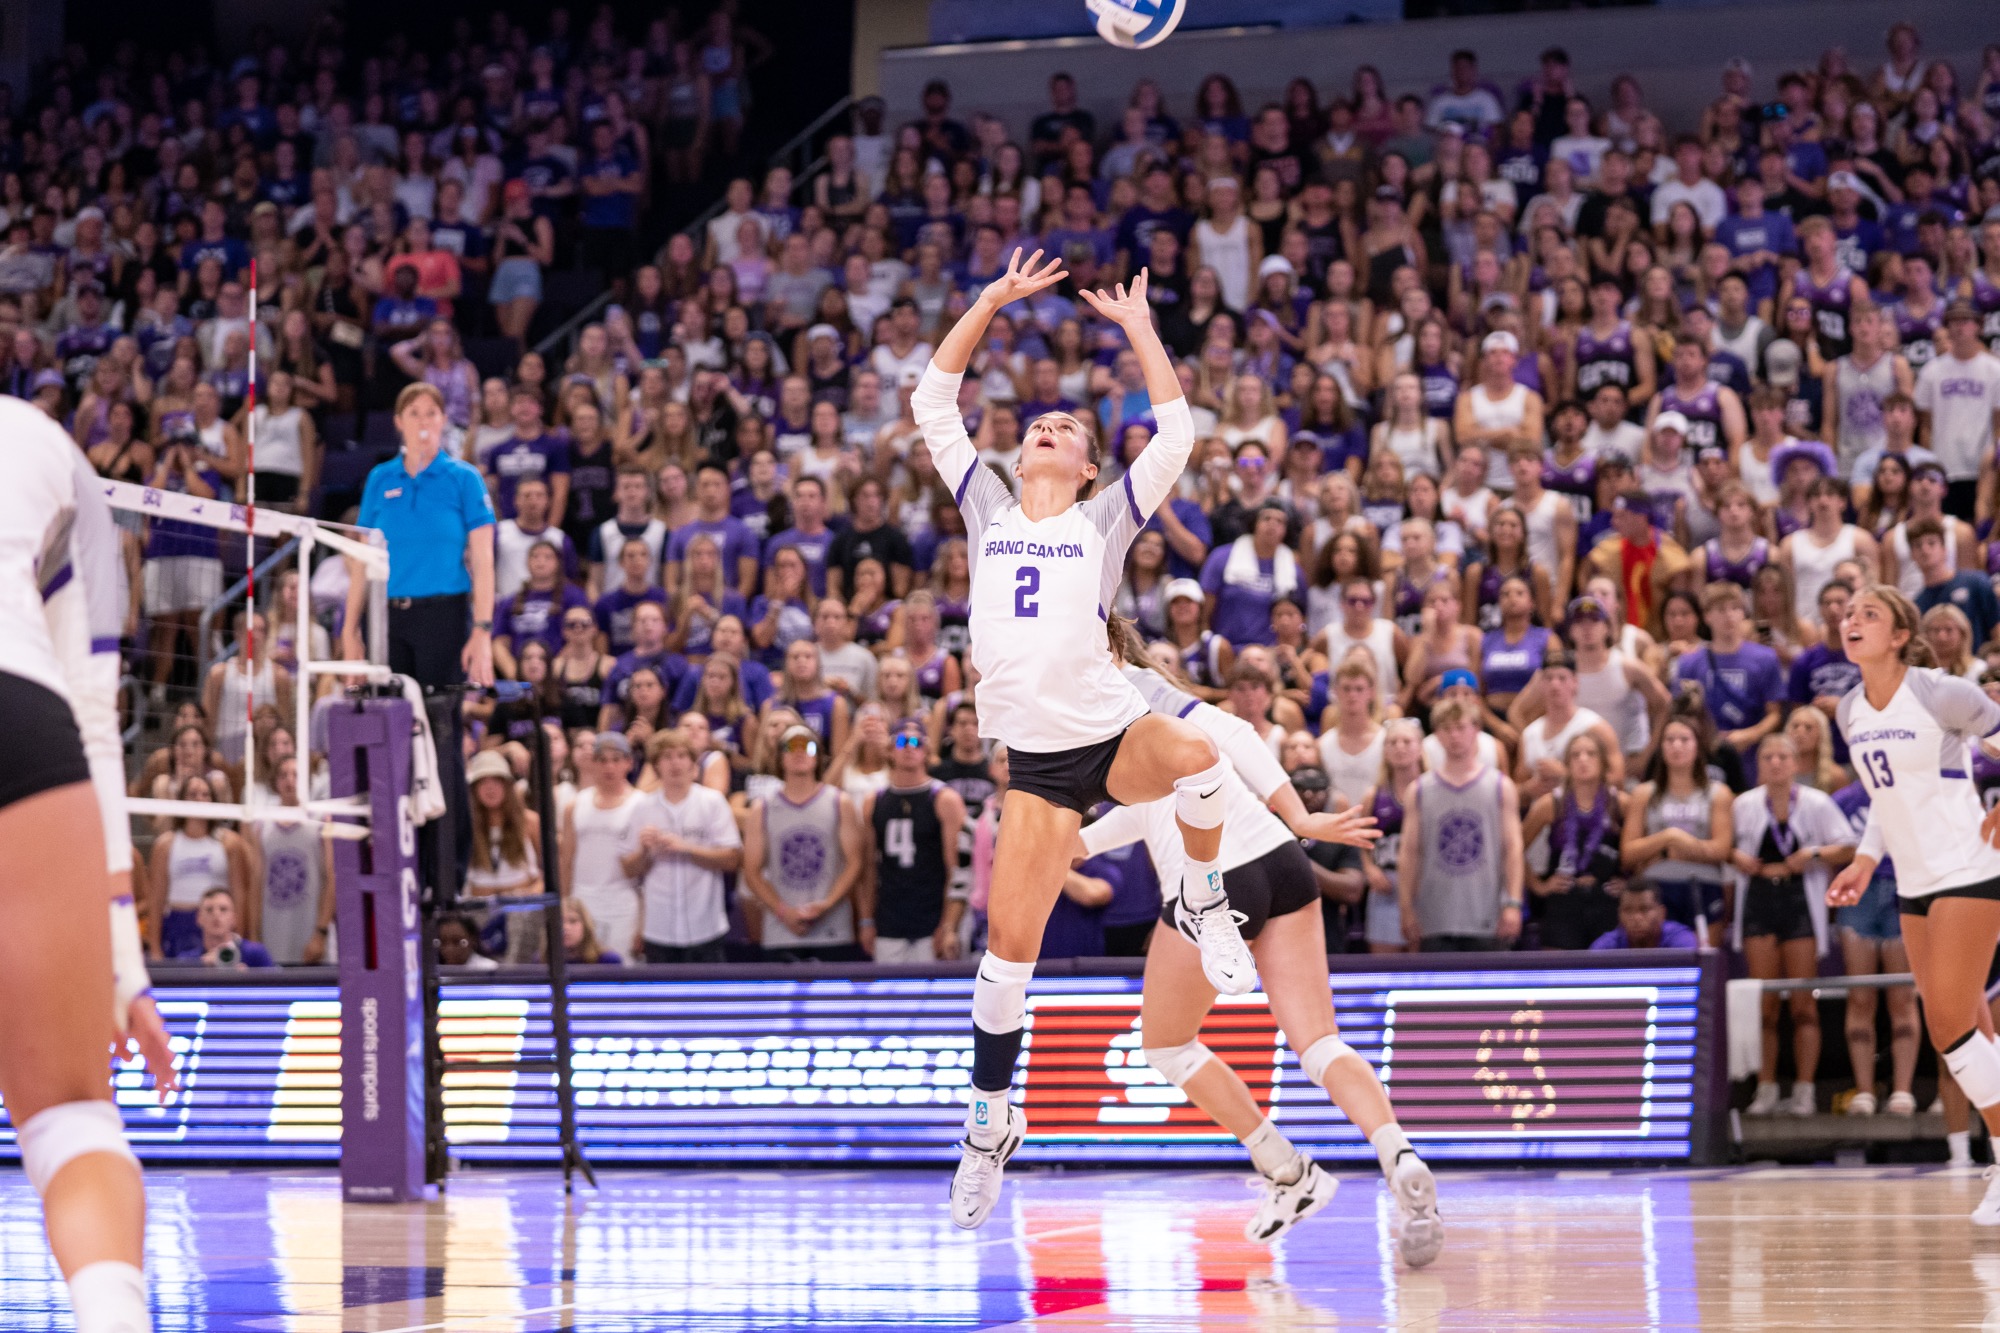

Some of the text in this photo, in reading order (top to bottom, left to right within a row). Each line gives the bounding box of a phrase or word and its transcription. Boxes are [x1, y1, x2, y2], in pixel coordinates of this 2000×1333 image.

[1940, 379, 1984, 398] GCU
[1027, 542, 1084, 558] CANYON
[1015, 566, 1040, 617] 2
[1862, 750, 1894, 789] 13
[885, 818, 916, 868] 4
